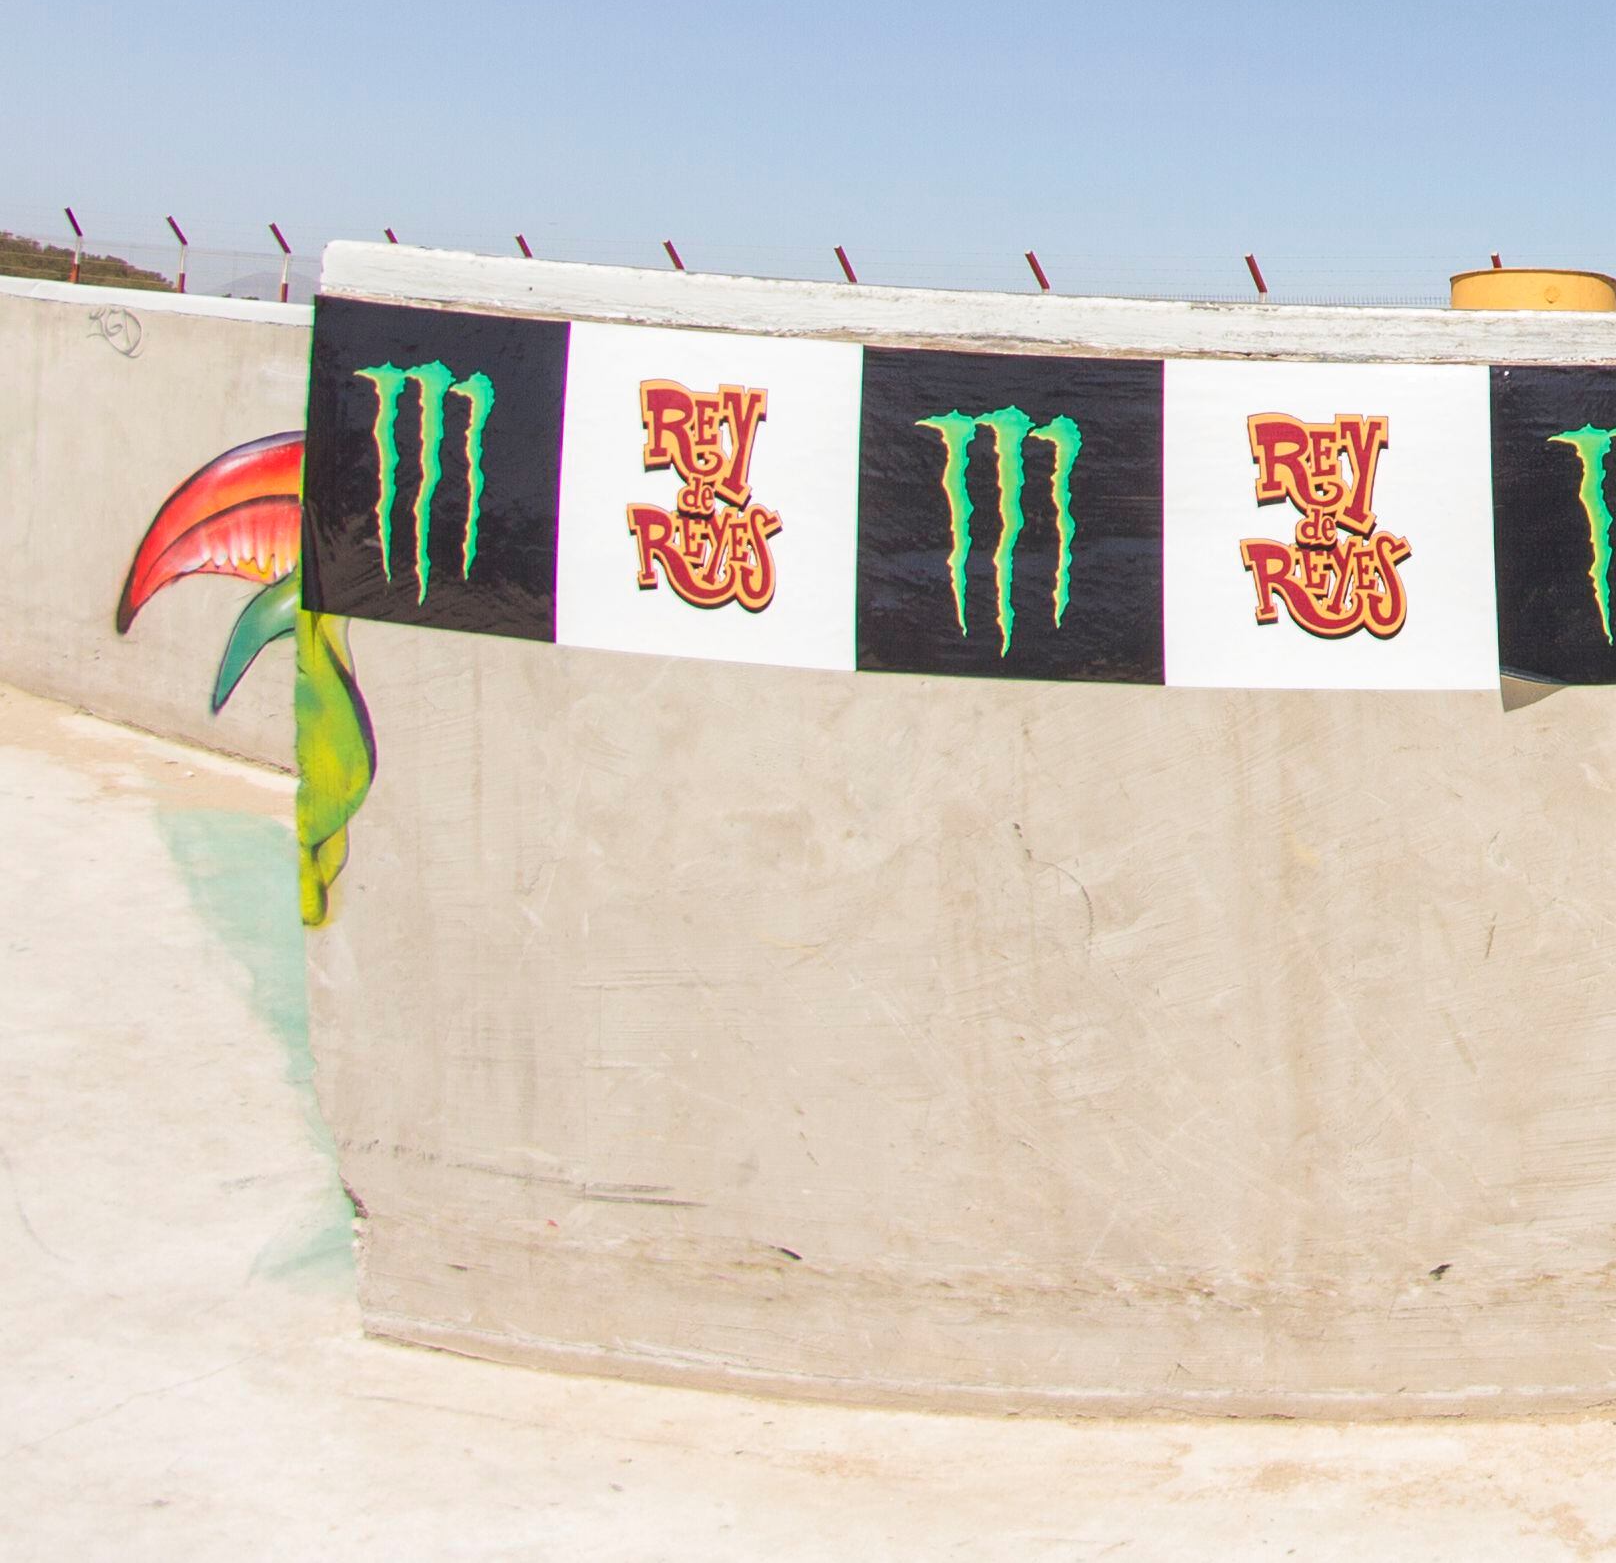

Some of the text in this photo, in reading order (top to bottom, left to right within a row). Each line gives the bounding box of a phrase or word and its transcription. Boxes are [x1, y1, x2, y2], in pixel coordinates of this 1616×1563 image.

[640, 379, 768, 505] REY
[679, 474, 715, 512] de
[1248, 412, 1388, 535] REY
[627, 503, 782, 611] REYES
[1297, 507, 1337, 544] de
[1240, 531, 1411, 636] REYES
